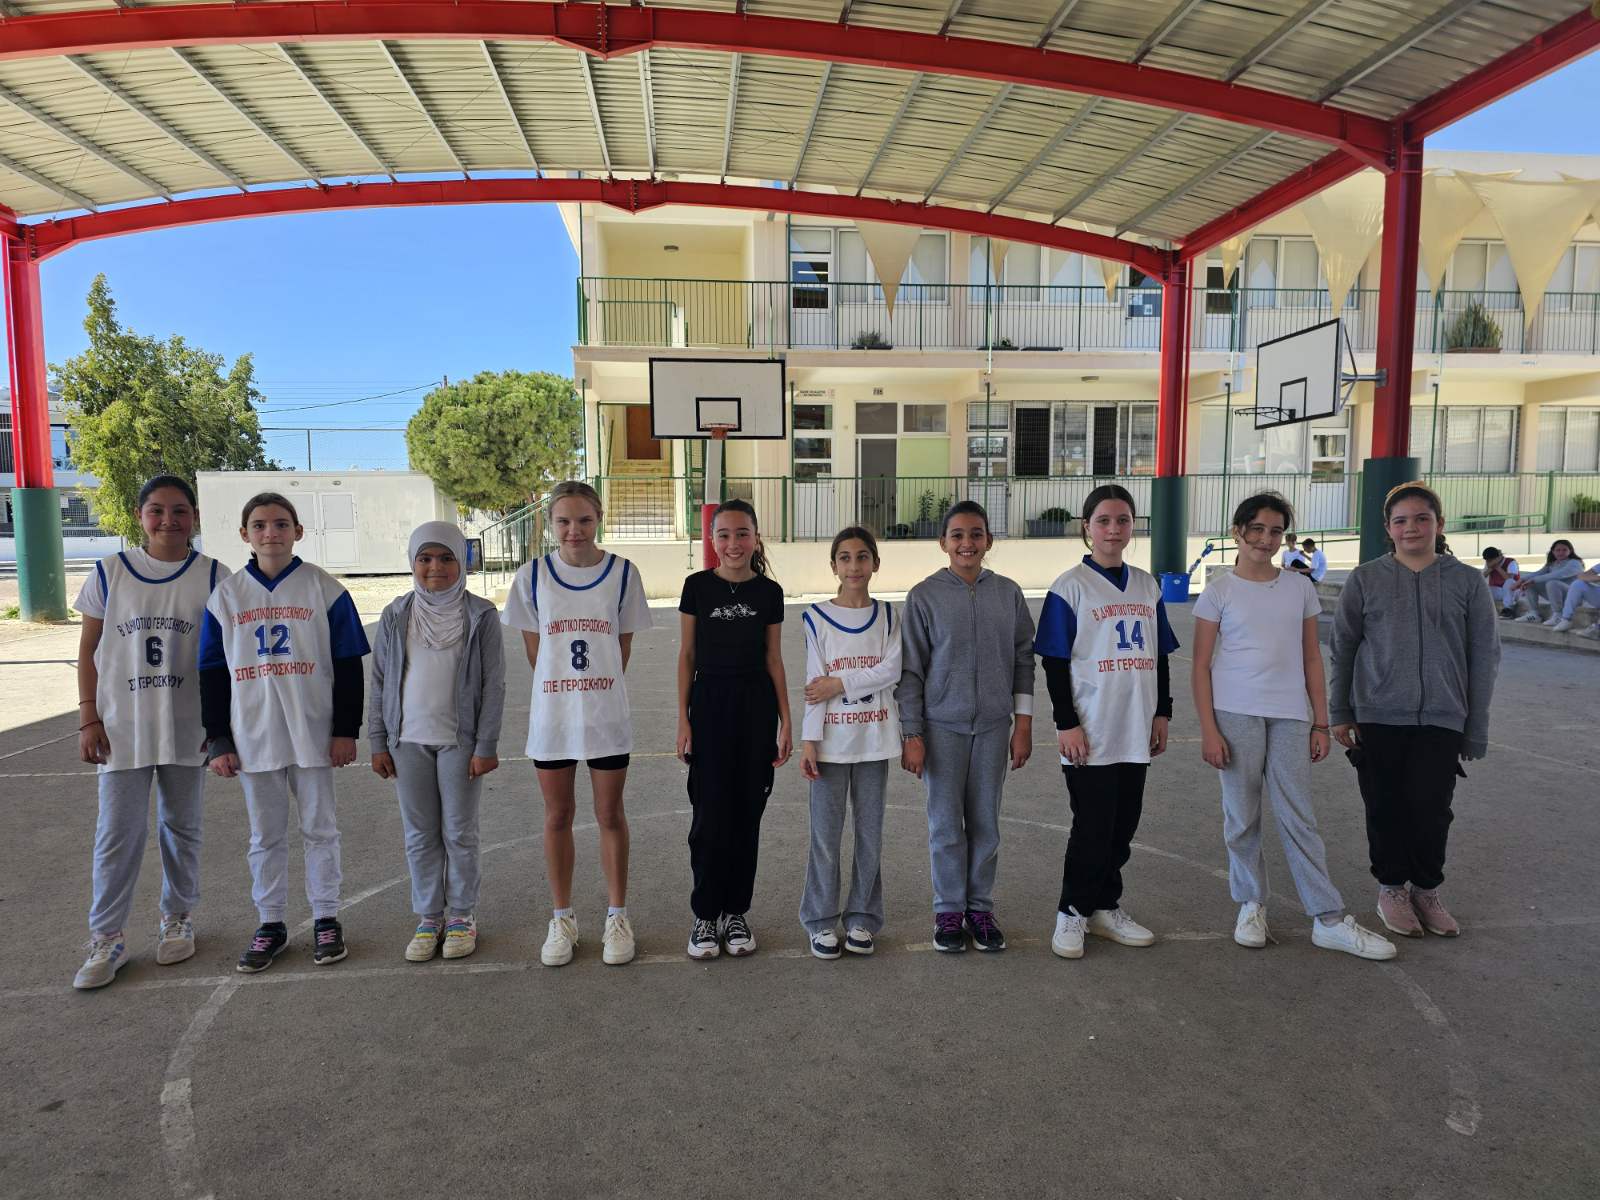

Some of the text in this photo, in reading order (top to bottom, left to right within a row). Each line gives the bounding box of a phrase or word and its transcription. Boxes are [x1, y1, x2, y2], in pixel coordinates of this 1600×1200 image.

[238, 607, 270, 624] ΔΗΜΟΤΙΚΟ
[270, 606, 314, 621] ΓΕΡΟΣΚΗΠΟΥ
[577, 618, 613, 635] ΓΕΡΟΣΚΗΠΟ
[1115, 620, 1144, 651] 14
[255, 624, 291, 657] 12
[146, 636, 163, 667] 6
[571, 640, 589, 671] 8
[235, 662, 315, 682] ΣΠΕ ΓΕΡΟΣΚΗΠΟΥ
[1098, 659, 1115, 672] ΣΠΕ
[138, 675, 184, 689] ΓΕΡΟΣΚΗΟΥ
[560, 678, 614, 692] ΓΕΡΟΣΚΗΠΟΥ
[841, 708, 888, 725] ΓΕΡΟΣΚΗΟΥ
